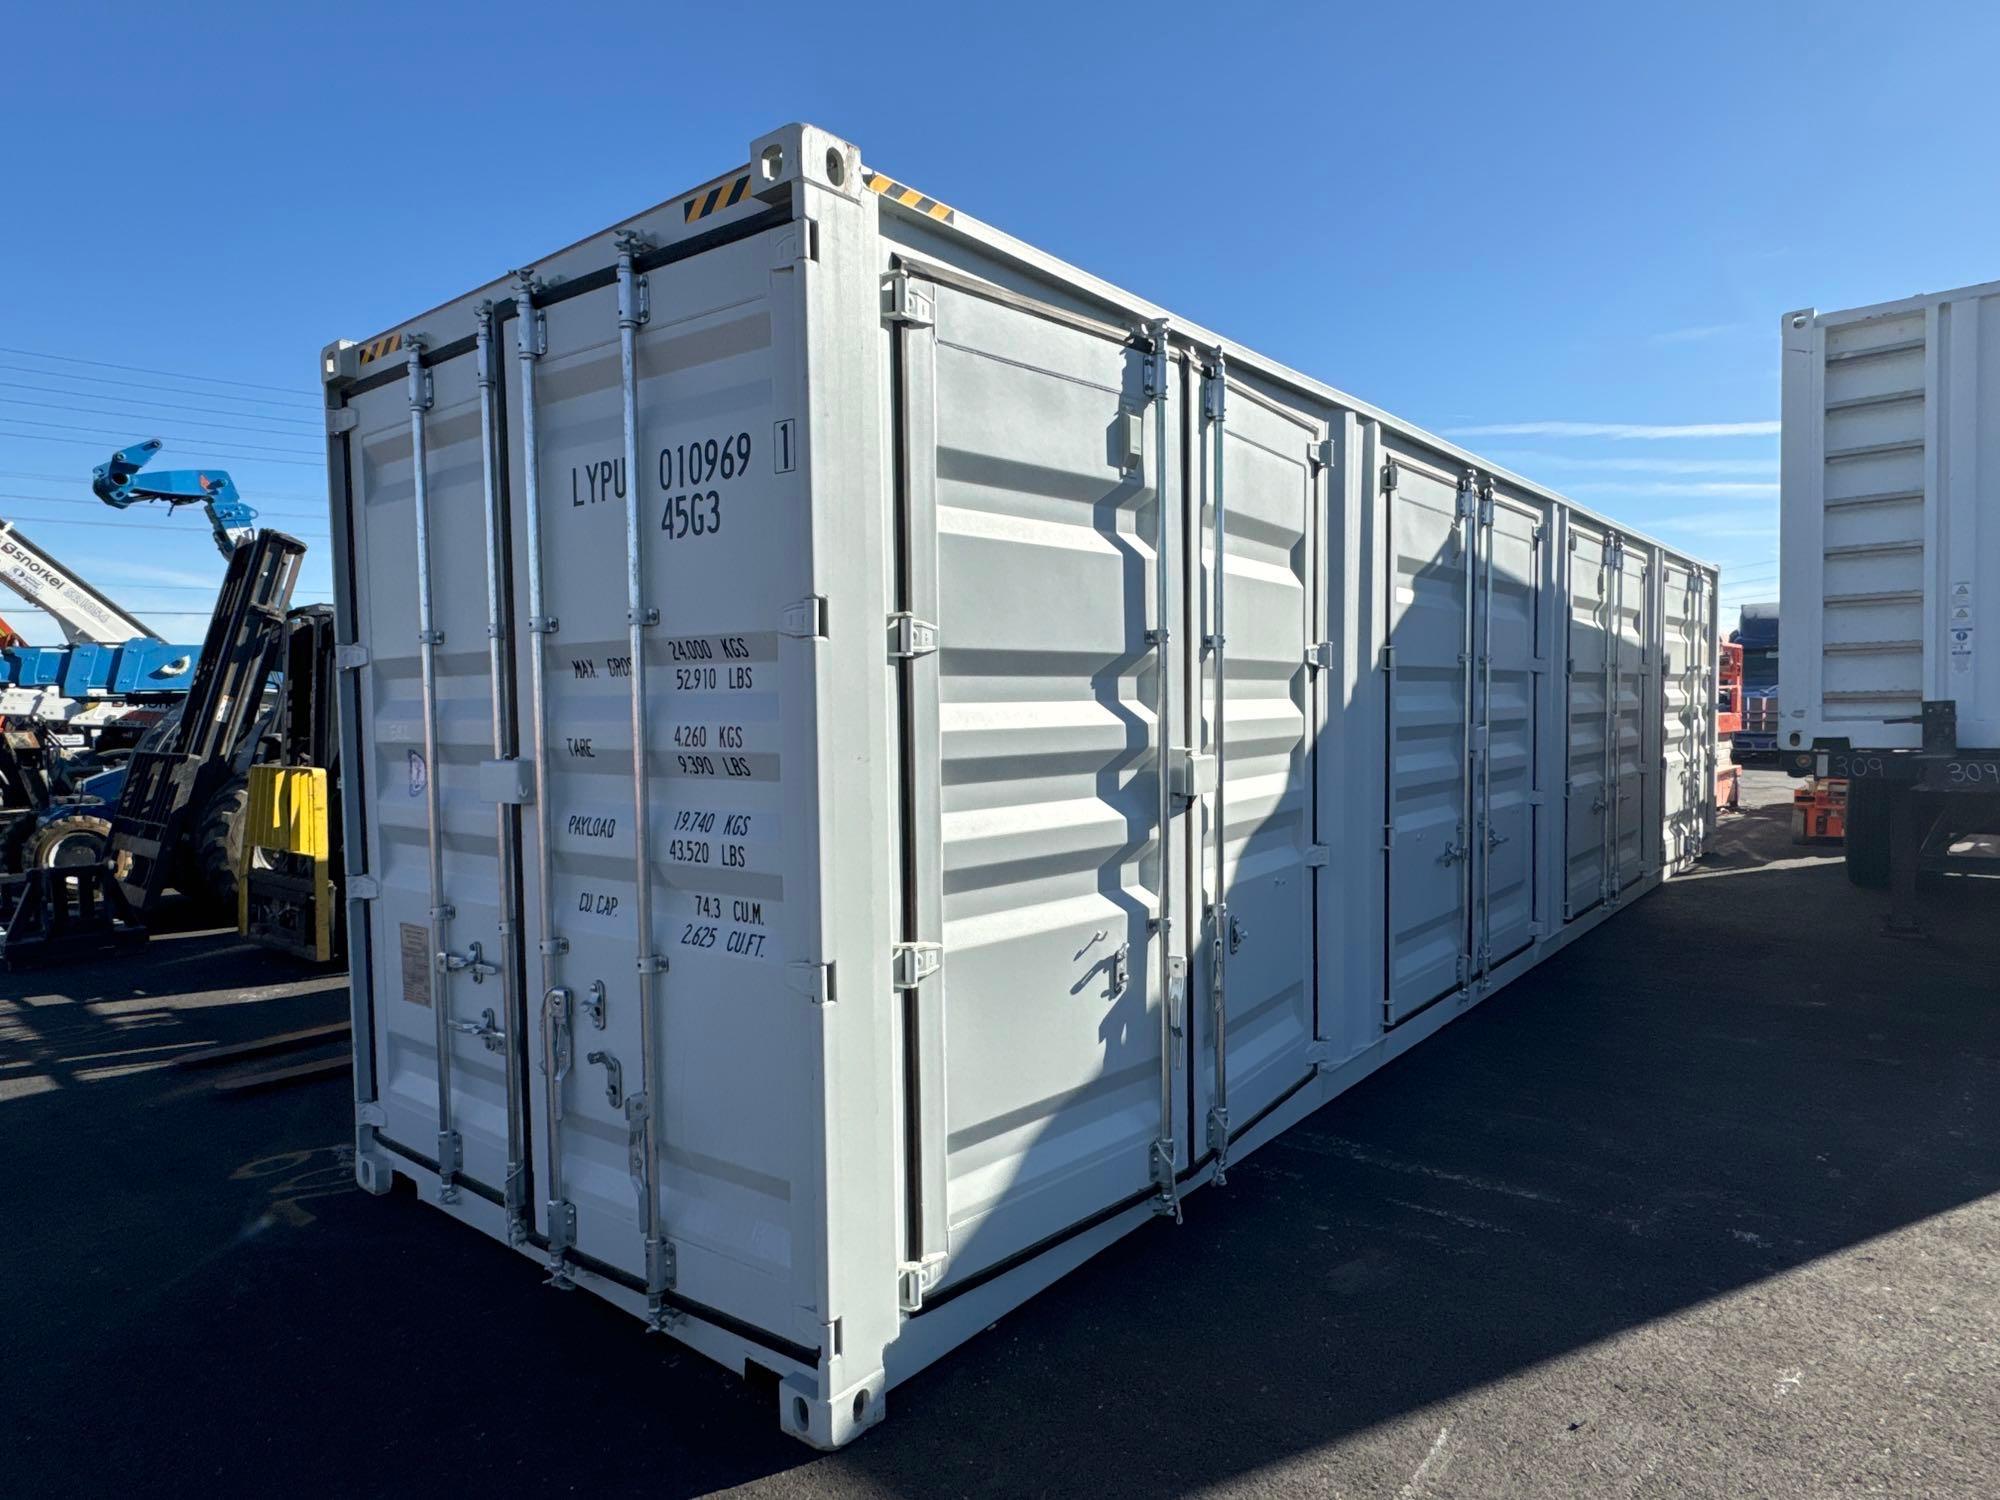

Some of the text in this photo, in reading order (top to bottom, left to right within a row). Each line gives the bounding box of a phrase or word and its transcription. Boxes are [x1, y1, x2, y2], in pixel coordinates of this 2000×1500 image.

[572, 423, 789, 507] LYPU 010969 1
[661, 490, 721, 540] 45G3
[12, 550, 65, 590] snorkel
[571, 659, 599, 679] MAX.
[720, 637, 750, 659] KGS
[728, 667, 753, 690] LBS
[566, 738, 596, 758] TARE
[719, 726, 743, 749] KGS
[721, 756, 752, 777] LBS
[1835, 755, 1884, 777] 309
[1946, 762, 2000, 785] 309
[568, 815, 617, 839] PAYLOAD
[723, 814, 752, 837] KGS
[721, 843, 746, 868] LBS
[596, 895, 619, 918] CAP.
[694, 894, 721, 919] 74.3
[733, 900, 766, 926] CU.M.
[726, 930, 767, 959] CU.FT.
